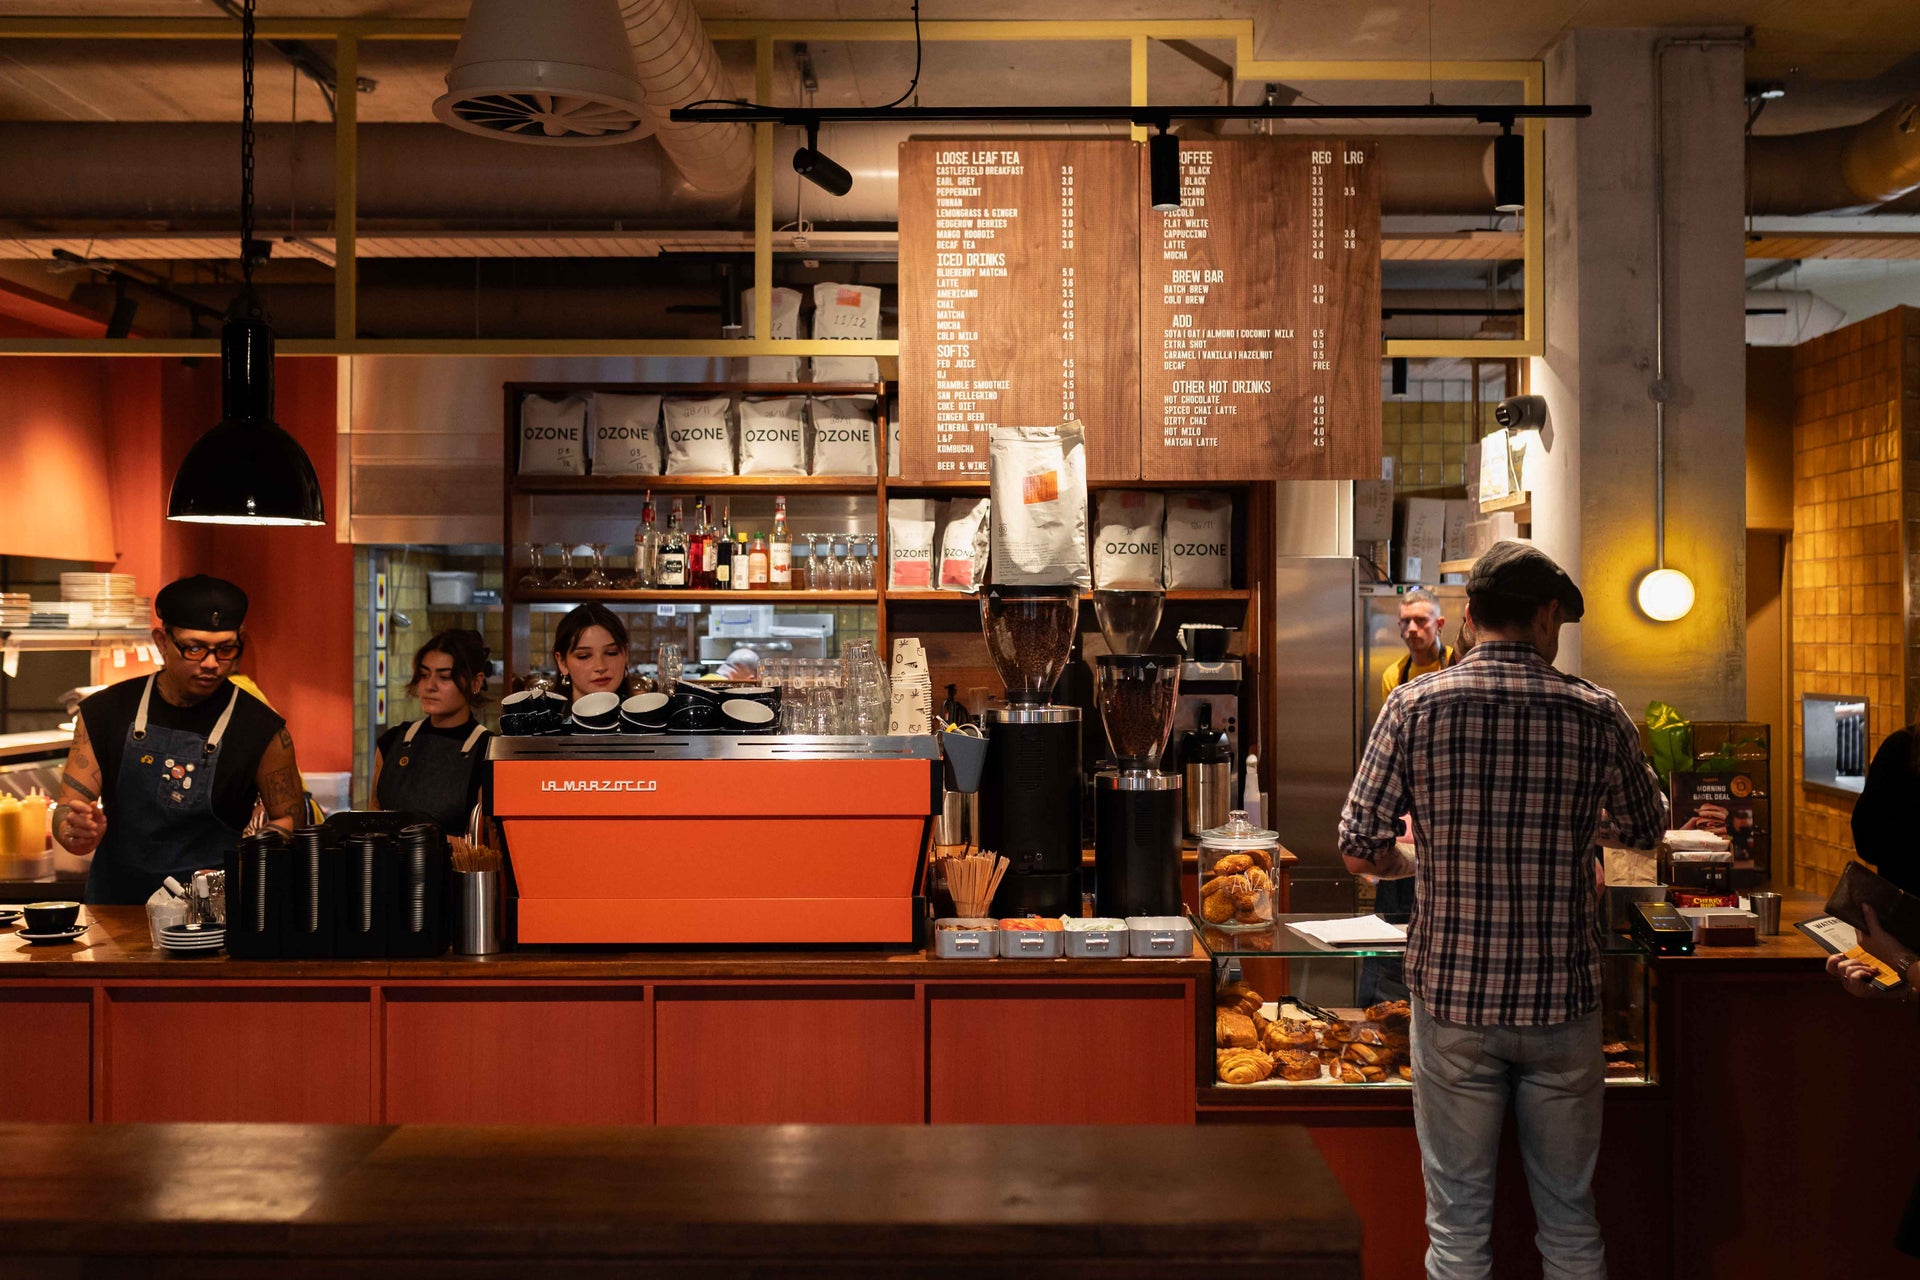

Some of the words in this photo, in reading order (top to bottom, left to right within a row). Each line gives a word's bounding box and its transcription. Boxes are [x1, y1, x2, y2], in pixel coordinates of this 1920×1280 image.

[936, 151, 969, 165] LOOSE
[972, 151, 999, 165] LEAF
[1000, 151, 1020, 165] TEA
[1179, 151, 1213, 165] OFFEE
[1311, 151, 1332, 165] REG
[1343, 151, 1364, 165] LRG
[936, 166, 984, 176] CASTLEFIELD
[985, 166, 1024, 176] BREAKFAST
[1062, 166, 1074, 176] 3.0
[1188, 166, 1211, 175] BLACK
[936, 176, 954, 186] EARL
[957, 176, 975, 186] GREY
[1062, 176, 1074, 186] 3.0
[1184, 176, 1207, 186] BLACK
[1312, 176, 1325, 186] 3.3
[936, 187, 981, 196] PEPPERMINT
[1062, 187, 1074, 196] 3.0
[1180, 187, 1205, 196] RICANO
[1312, 187, 1325, 196] 3.3
[1344, 187, 1356, 196] 3.5
[1062, 198, 1074, 207] 3.0
[1312, 197, 1325, 207] 3.3
[936, 208, 982, 218] LEMONGRASS
[991, 208, 1018, 218] GINGER
[1062, 208, 1074, 218] 3.0
[1312, 208, 1325, 218] 3.3
[936, 219, 974, 228] HEDGEROW
[976, 219, 1008, 228] BERRIES
[1062, 219, 1074, 228] 3.0
[1163, 218, 1181, 228] FLAT
[1185, 218, 1209, 228] WHITE
[1312, 218, 1325, 228] 3.4
[936, 229, 961, 239] MANGO
[1062, 229, 1074, 239] 3.0
[1163, 229, 1207, 239] CAPPUCCINO
[1312, 229, 1325, 239] 3.4
[936, 240, 959, 250] DECAF
[962, 240, 976, 250] TEA
[1062, 240, 1074, 250] 3.0
[1163, 240, 1186, 250] LATTE
[1312, 240, 1325, 250] 3.4
[936, 252, 963, 267] ICED
[965, 252, 1006, 267] DRINKS
[1163, 250, 1188, 260] MOCHA
[1312, 250, 1325, 260] 4.0
[936, 268, 976, 277] BLUEBERRY
[978, 268, 1008, 277] MATCHA
[1062, 268, 1074, 277] 5.0
[1172, 269, 1201, 284] BREW
[1204, 269, 1224, 284] BAR
[936, 278, 959, 288] LATTE
[936, 289, 979, 298] AMERICANO
[1062, 289, 1074, 298] 3.5
[1163, 284, 1186, 294] BATCH
[1189, 284, 1210, 294] BREW
[1312, 284, 1325, 294] 3.0
[936, 299, 955, 309] CHAI
[1062, 299, 1074, 309] 4.0
[1163, 295, 1182, 305] COLD
[1184, 295, 1205, 305] BREW
[936, 310, 966, 319] MATCHA
[1062, 310, 1074, 319] 4.5
[936, 321, 961, 330] MOCHA
[1062, 321, 1074, 330] 4.0
[1172, 314, 1193, 328] ADD
[936, 331, 955, 341] COLD
[957, 331, 979, 341] MILO
[1062, 331, 1074, 341] 4.5
[1274, 328, 1294, 339] MILK
[1312, 328, 1325, 339] 0.5
[1163, 339, 1186, 349] EXTRA
[1189, 339, 1207, 349] SHOT
[1312, 339, 1325, 349] 0.5
[936, 344, 970, 358] SOFTS
[1312, 350, 1325, 360] 0.5
[954, 359, 977, 369] JUICE
[1062, 359, 1074, 369] 4.5
[1163, 360, 1186, 371] DECAF
[1312, 360, 1331, 371] FREE
[1062, 370, 1074, 379] 4.0
[936, 380, 970, 390] BRAMBLE
[973, 380, 1011, 390] SMOOTHIE
[1062, 380, 1074, 390] 4.5
[1172, 380, 1205, 394] OTHER
[1208, 380, 1229, 394] HOT
[1231, 380, 1271, 394] DRINKS
[936, 391, 951, 400] SAN
[953, 391, 998, 400] PELLEGRINO
[1062, 391, 1074, 400] 3.0
[1163, 395, 1178, 405] HOT
[1180, 395, 1220, 405] CHOCOLATE
[936, 401, 955, 411] COKE
[958, 401, 976, 411] DIET
[1062, 401, 1074, 411] 3.0
[1163, 405, 1191, 415] SPICED
[1193, 405, 1212, 415] CHAI
[1215, 405, 1237, 415] LATTE
[936, 412, 964, 422] GINGER
[966, 412, 985, 422] BEER
[1062, 412, 1074, 422] 4.0
[1163, 416, 1186, 426] DIRTY
[1189, 416, 1208, 426] CHAI
[1312, 416, 1325, 426] 4.3
[936, 423, 968, 432] MINERAL
[1163, 426, 1178, 436] HOT
[1181, 426, 1202, 436] MILO
[1312, 426, 1325, 436] 4.0
[524, 427, 579, 441] OZONE
[597, 427, 649, 441] OZONE
[670, 427, 724, 443] OZONE
[745, 429, 799, 443] OZONE
[819, 429, 870, 443] OZONE
[1163, 437, 1193, 447] MATCHA
[1196, 437, 1218, 447] LATTE
[1312, 437, 1325, 447] 4.5
[937, 444, 975, 454] KOMBUCHA
[937, 461, 955, 471] BEER
[967, 461, 987, 471] WINE
[894, 549, 929, 558] OZONE
[1105, 542, 1159, 555] OZONE
[1173, 543, 1227, 556] OZONE
[564, 780, 657, 791] MARZOCCO
[1696, 785, 1726, 793] MORNING
[1714, 793, 1731, 801] DEAL
